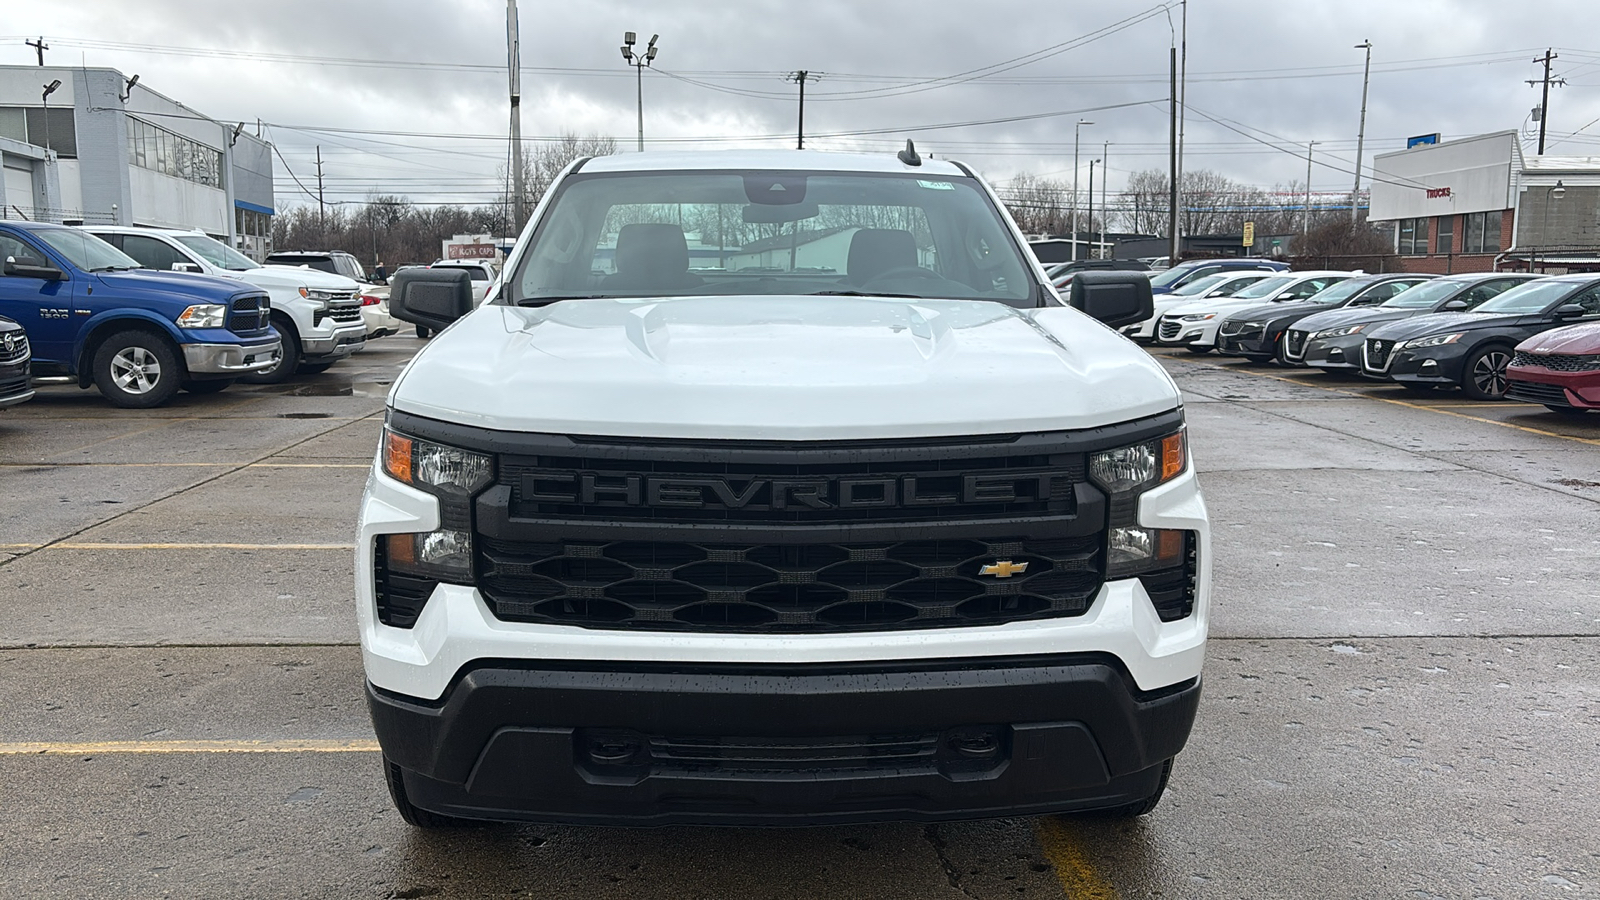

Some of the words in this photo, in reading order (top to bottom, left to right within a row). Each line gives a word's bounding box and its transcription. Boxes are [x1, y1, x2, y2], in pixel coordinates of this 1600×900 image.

[1426, 187, 1451, 199] TRUCKS
[478, 247, 494, 255] CAPS
[521, 471, 1070, 509] CHEVROLET
